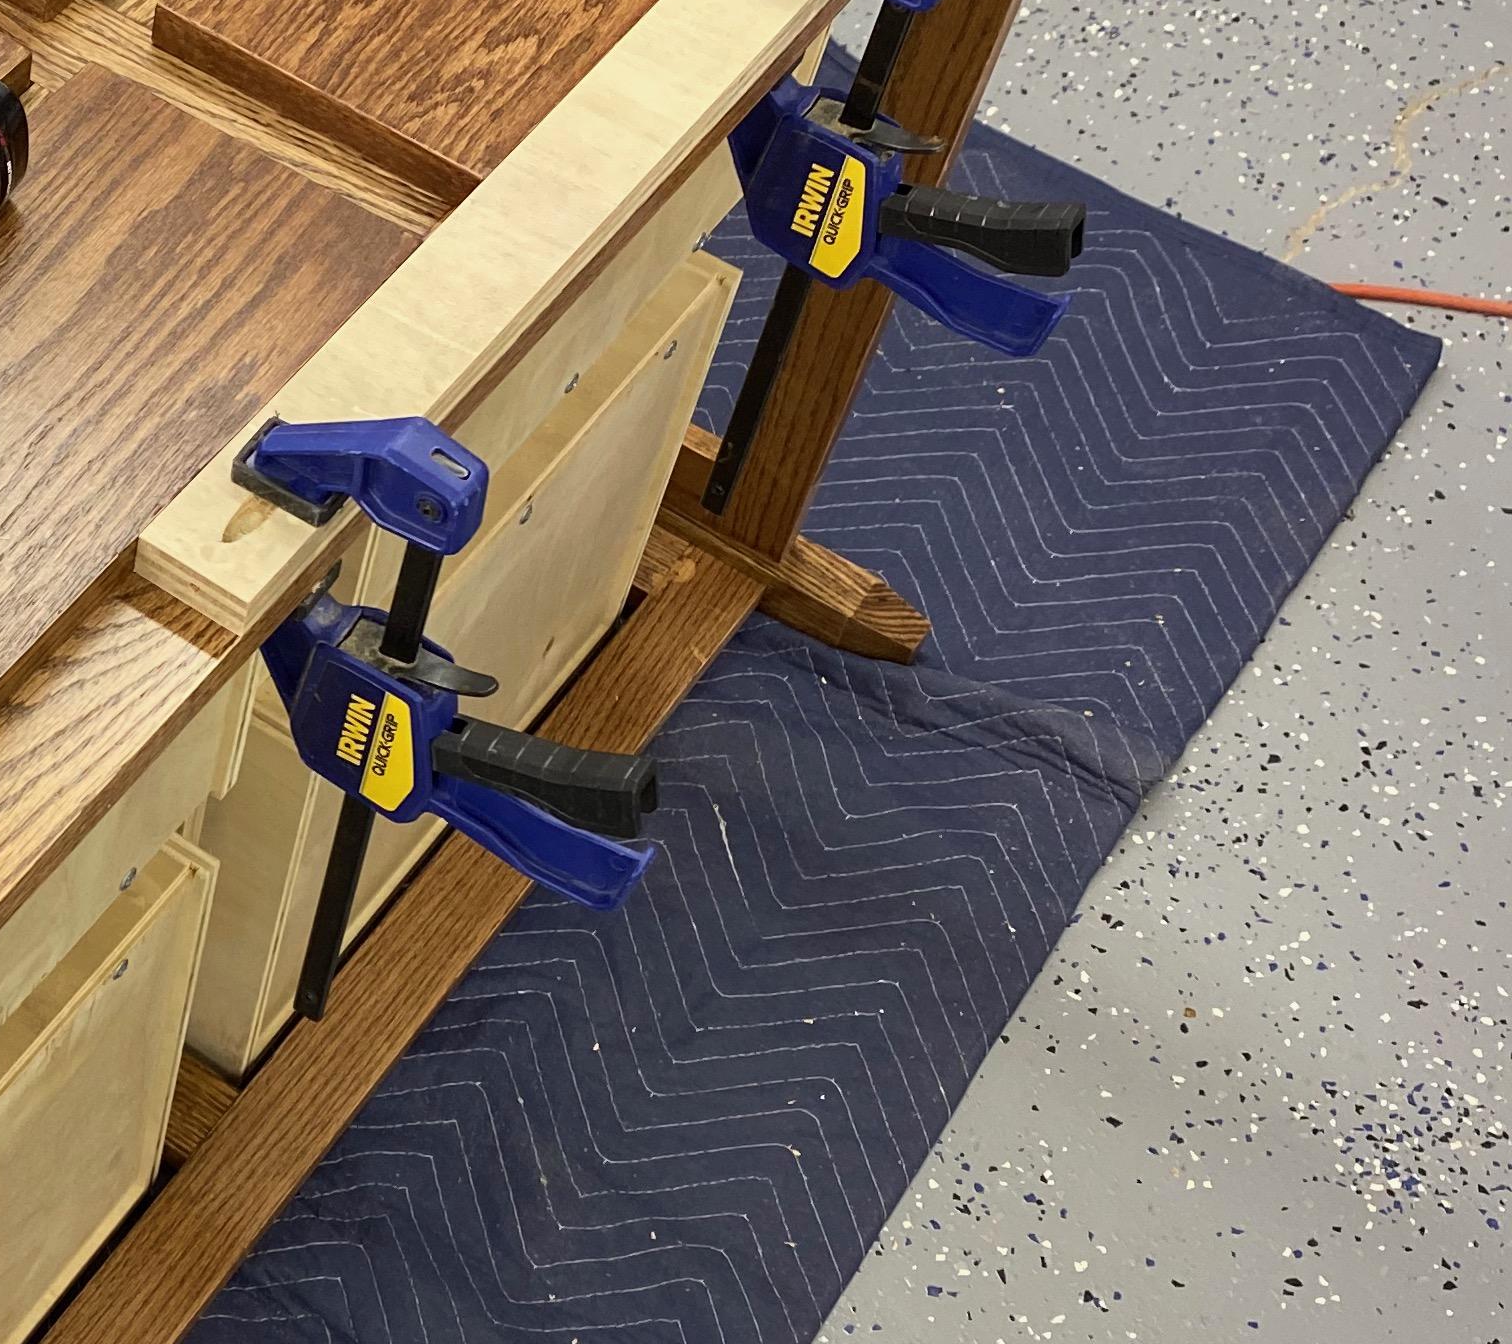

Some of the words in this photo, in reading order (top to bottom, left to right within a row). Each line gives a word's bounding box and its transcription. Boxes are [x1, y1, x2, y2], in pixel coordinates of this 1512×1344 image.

[791, 162, 835, 238] IRWIN
[823, 178, 854, 246] QUICK-GRIP
[335, 693, 377, 766] IRWIN
[372, 713, 398, 777] QUICK-GRIP
